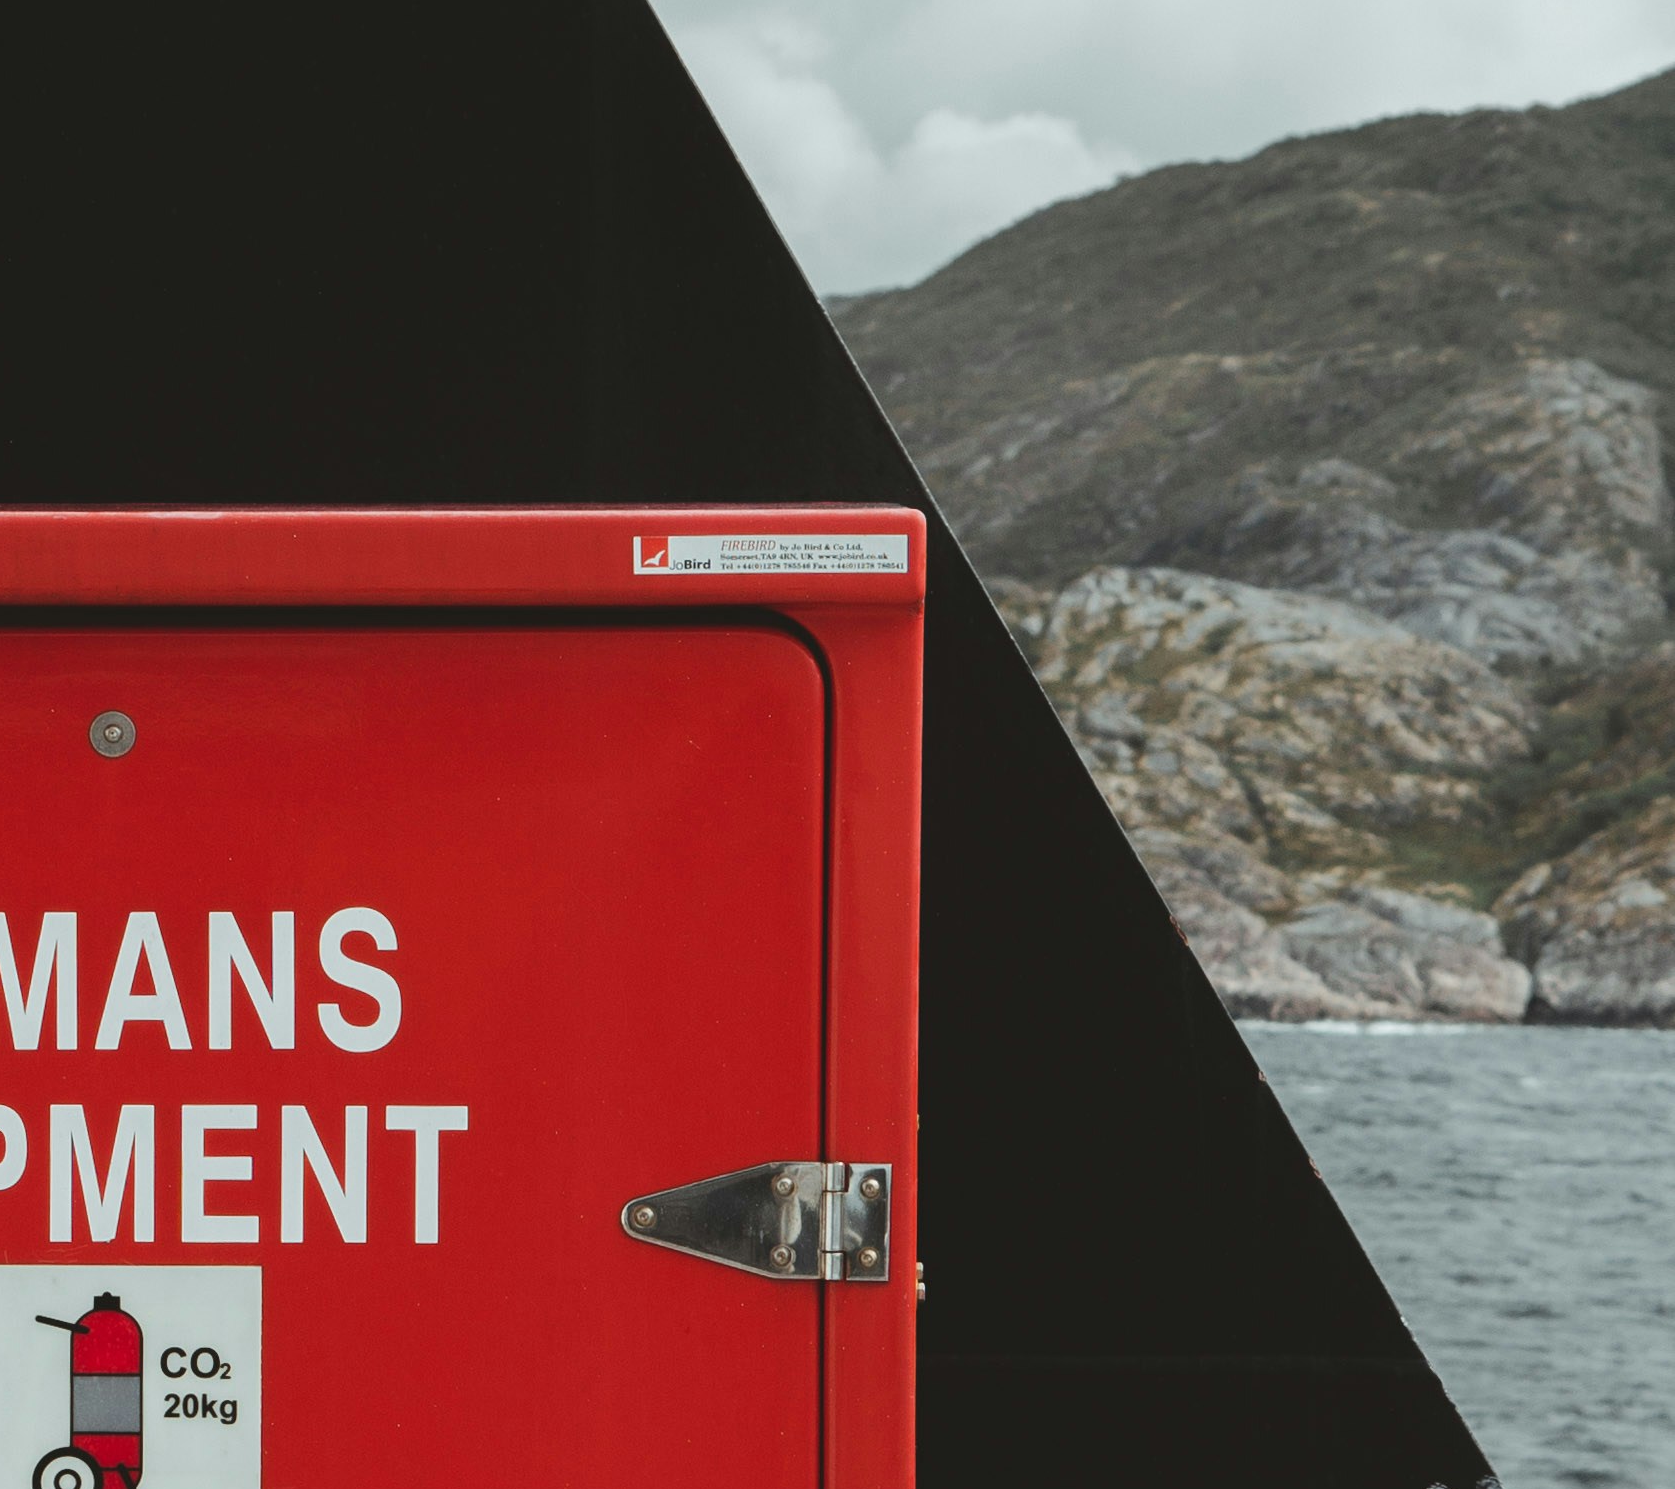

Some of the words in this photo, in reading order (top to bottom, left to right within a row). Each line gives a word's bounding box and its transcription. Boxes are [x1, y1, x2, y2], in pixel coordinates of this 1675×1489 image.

[721, 540, 776, 551] FIREBIRD
[780, 544, 789, 552] by
[669, 558, 711, 571] JoBird
[163, 1393, 239, 1425] 20kg
